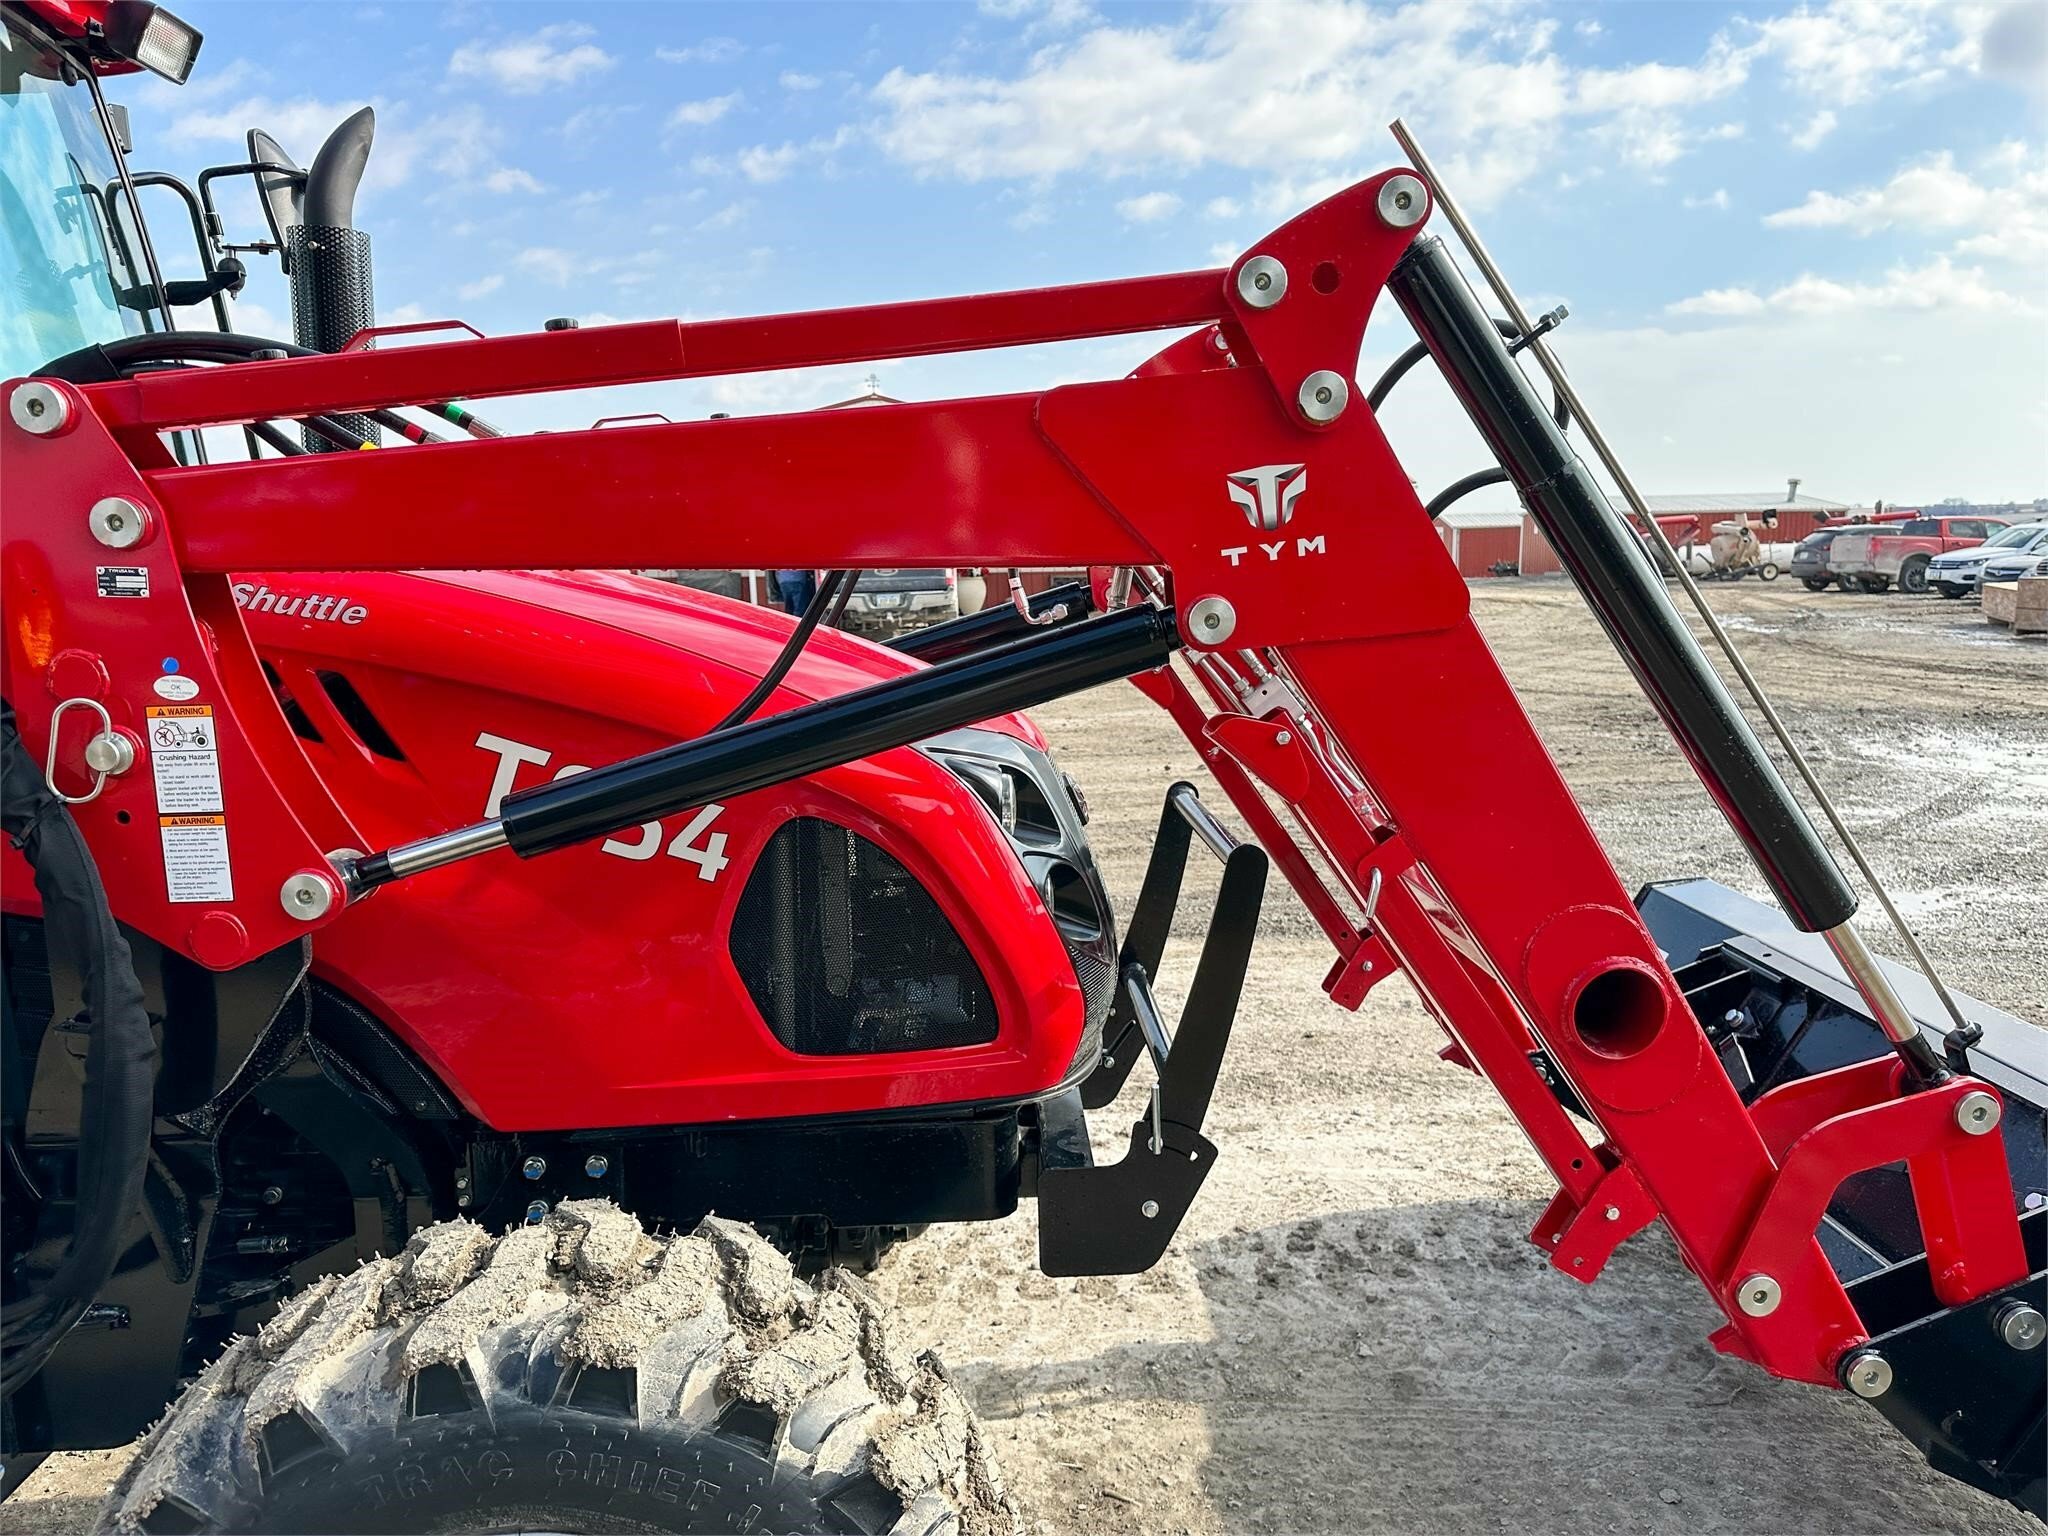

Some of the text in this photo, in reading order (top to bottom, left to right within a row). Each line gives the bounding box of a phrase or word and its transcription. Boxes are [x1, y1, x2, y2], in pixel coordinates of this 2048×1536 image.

[1221, 535, 1327, 566] TYM
[231, 583, 368, 625] Shuttle
[167, 707, 204, 716] WARNING
[355, 1448, 722, 1510] TRAC CHIEF
